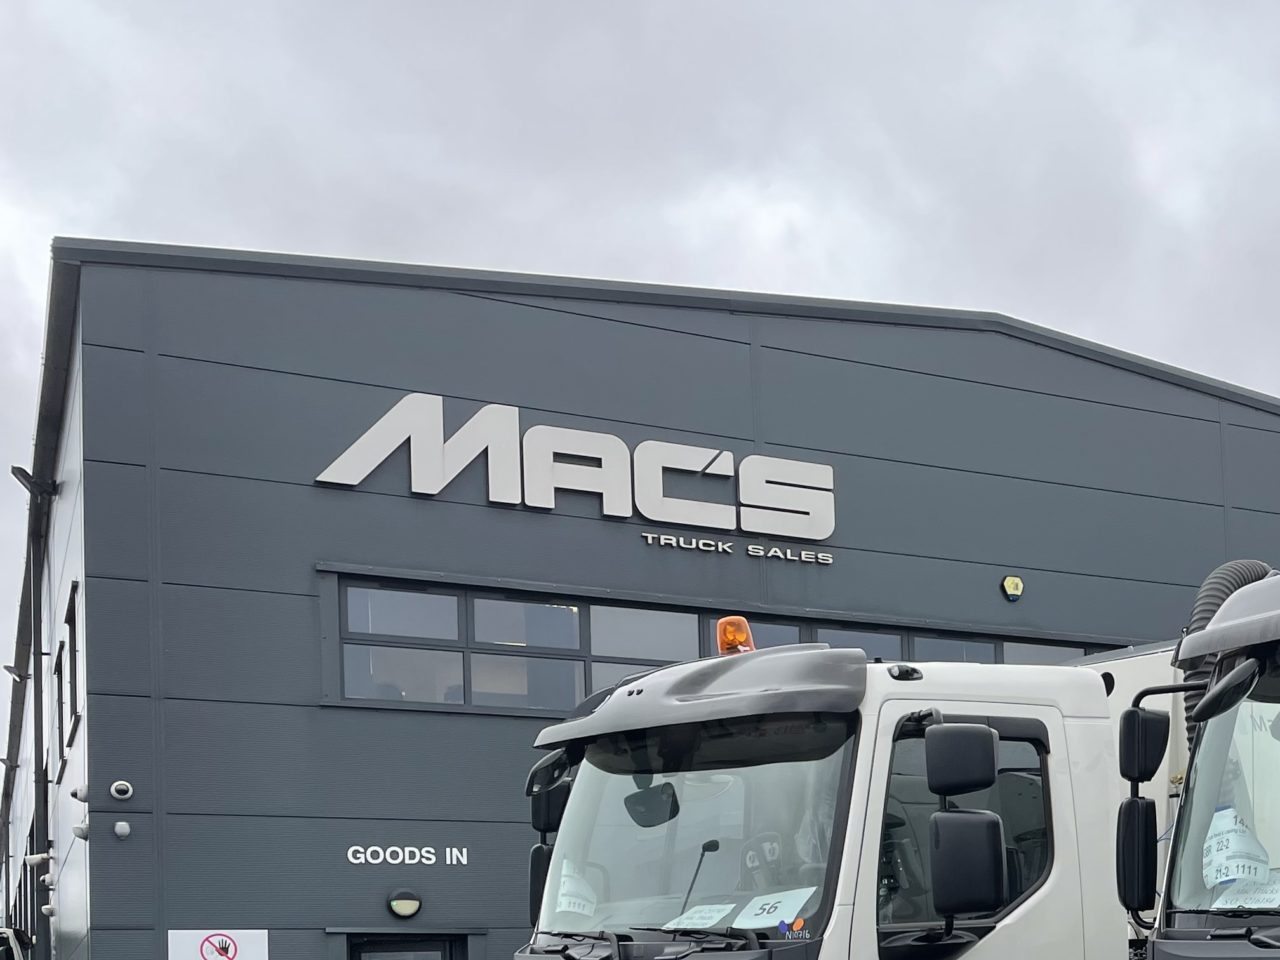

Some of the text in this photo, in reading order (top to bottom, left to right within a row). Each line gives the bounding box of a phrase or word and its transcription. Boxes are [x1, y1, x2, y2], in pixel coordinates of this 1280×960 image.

[641, 532, 834, 565] TRUCK SALES
[347, 845, 468, 865] GOODS IN
[1236, 864, 1258, 877] 1111
[754, 901, 782, 916] 56
